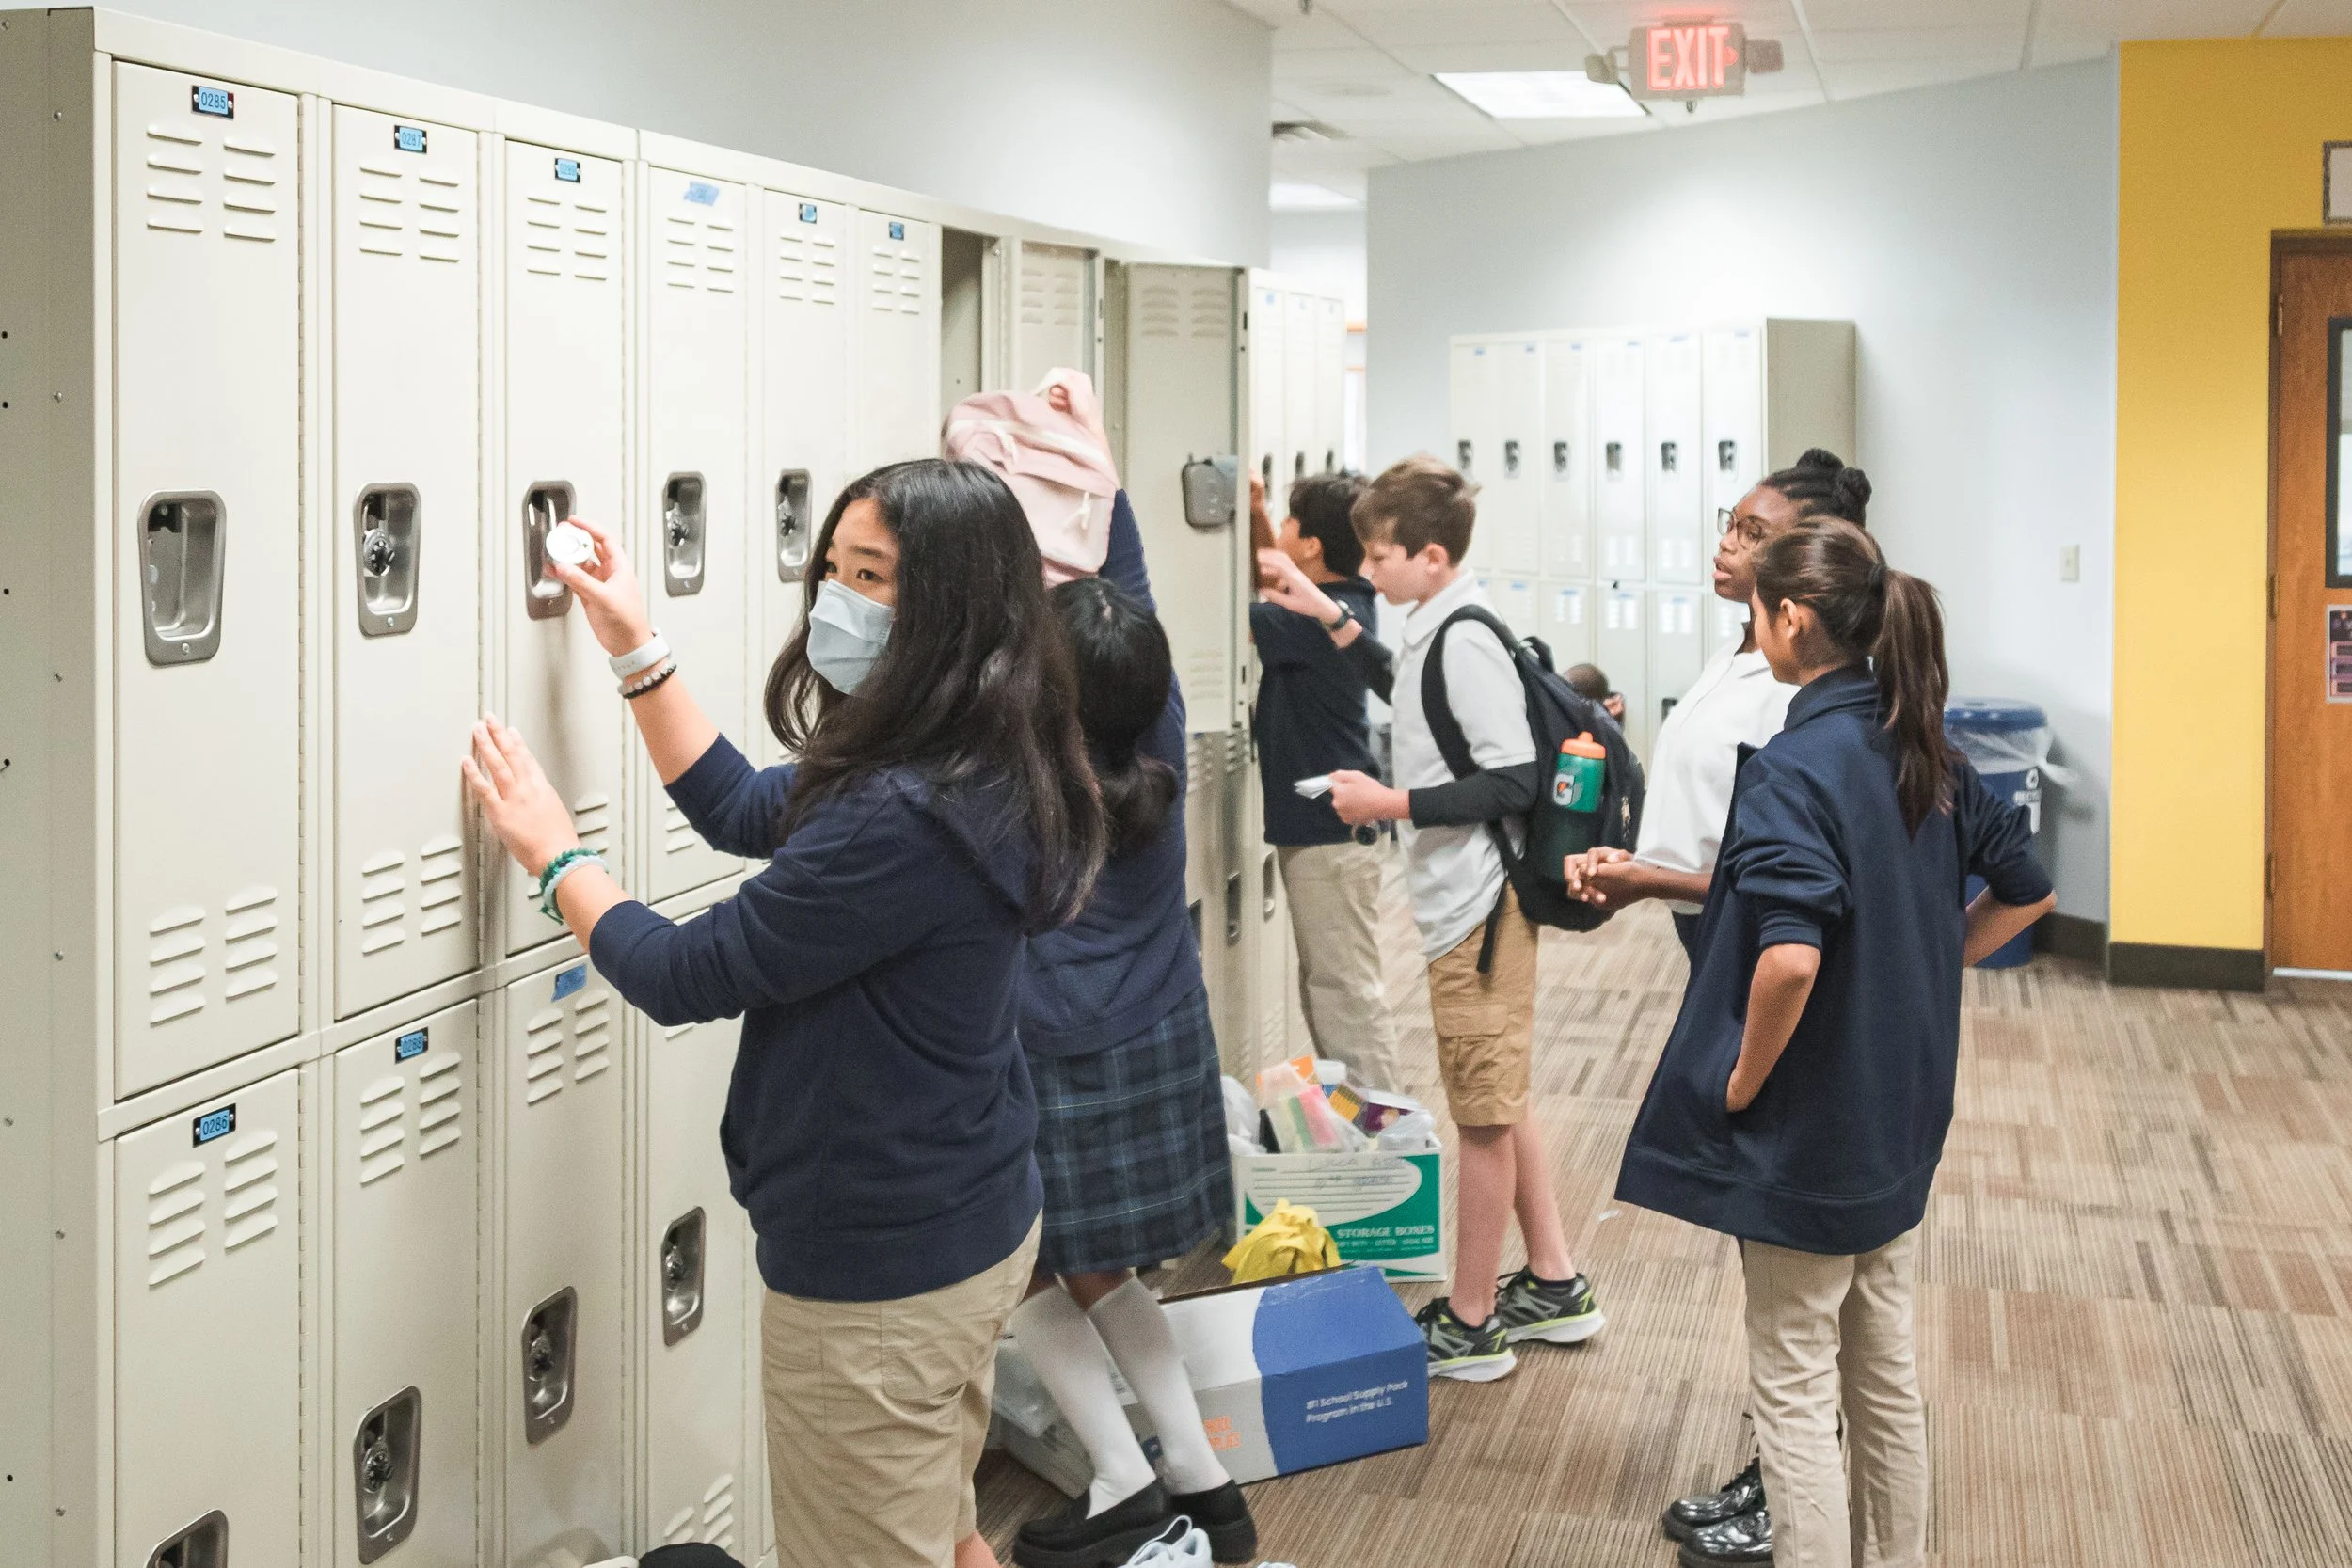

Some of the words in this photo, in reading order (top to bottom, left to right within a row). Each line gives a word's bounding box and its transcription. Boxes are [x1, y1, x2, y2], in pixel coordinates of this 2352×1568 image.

[1648, 25, 1730, 89] EXIT
[201, 92, 226, 110] 0285
[401, 132, 421, 148] 0287
[402, 1037, 421, 1053] 0288
[203, 1115, 228, 1136] 0286
[1337, 1227, 1391, 1238] STORAGE
[1394, 1225, 1435, 1236] BOXES
[1320, 1393, 1351, 1408] School
[1352, 1386, 1385, 1401] Supply
[1386, 1379, 1408, 1392] Pack
[1306, 1407, 1348, 1423] Program
[1349, 1404, 1359, 1414] in
[1359, 1402, 1375, 1412] the
